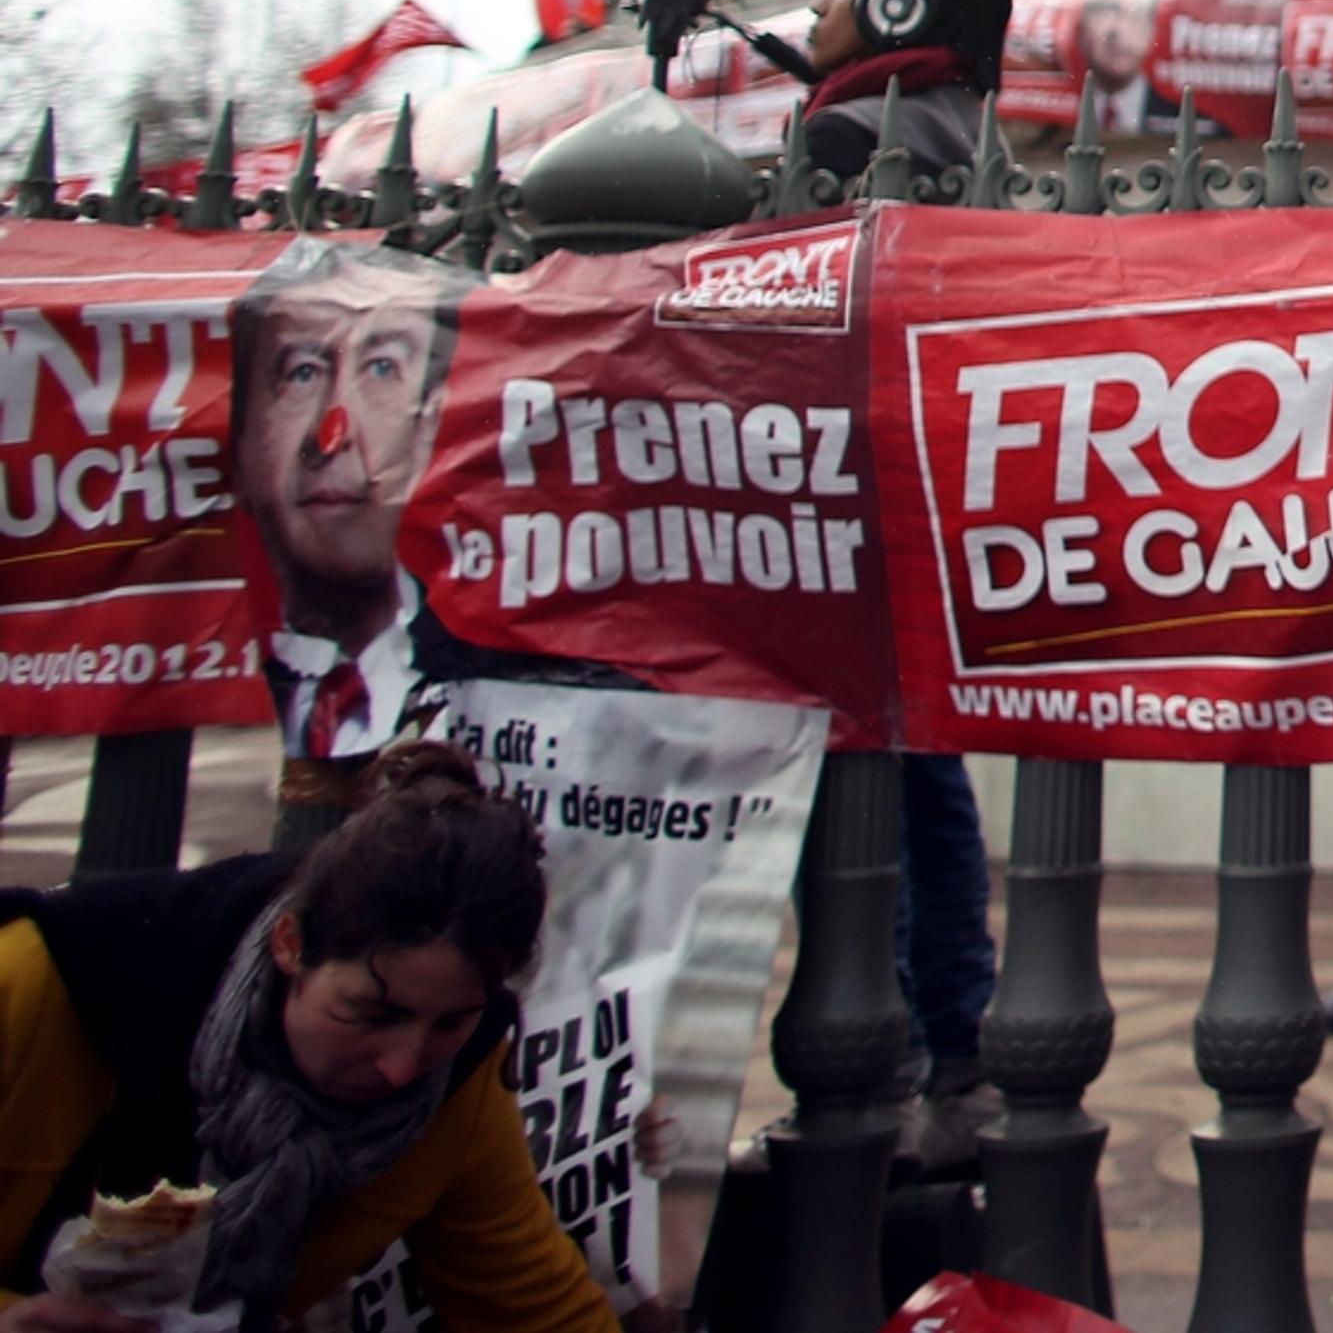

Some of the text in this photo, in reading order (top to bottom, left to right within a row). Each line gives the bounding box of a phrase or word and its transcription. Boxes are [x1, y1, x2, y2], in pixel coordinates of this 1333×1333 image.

[697, 235, 849, 287] FRONT
[500, 379, 859, 495] Prenez
[0, 438, 236, 539] UCHE
[442, 502, 865, 609] le pouvoir
[962, 515, 1108, 612] DE
[494, 719, 538, 766] dit
[560, 783, 712, 841] dégages
[521, 987, 631, 1095] PLOI
[538, 1141, 631, 1224] ON
